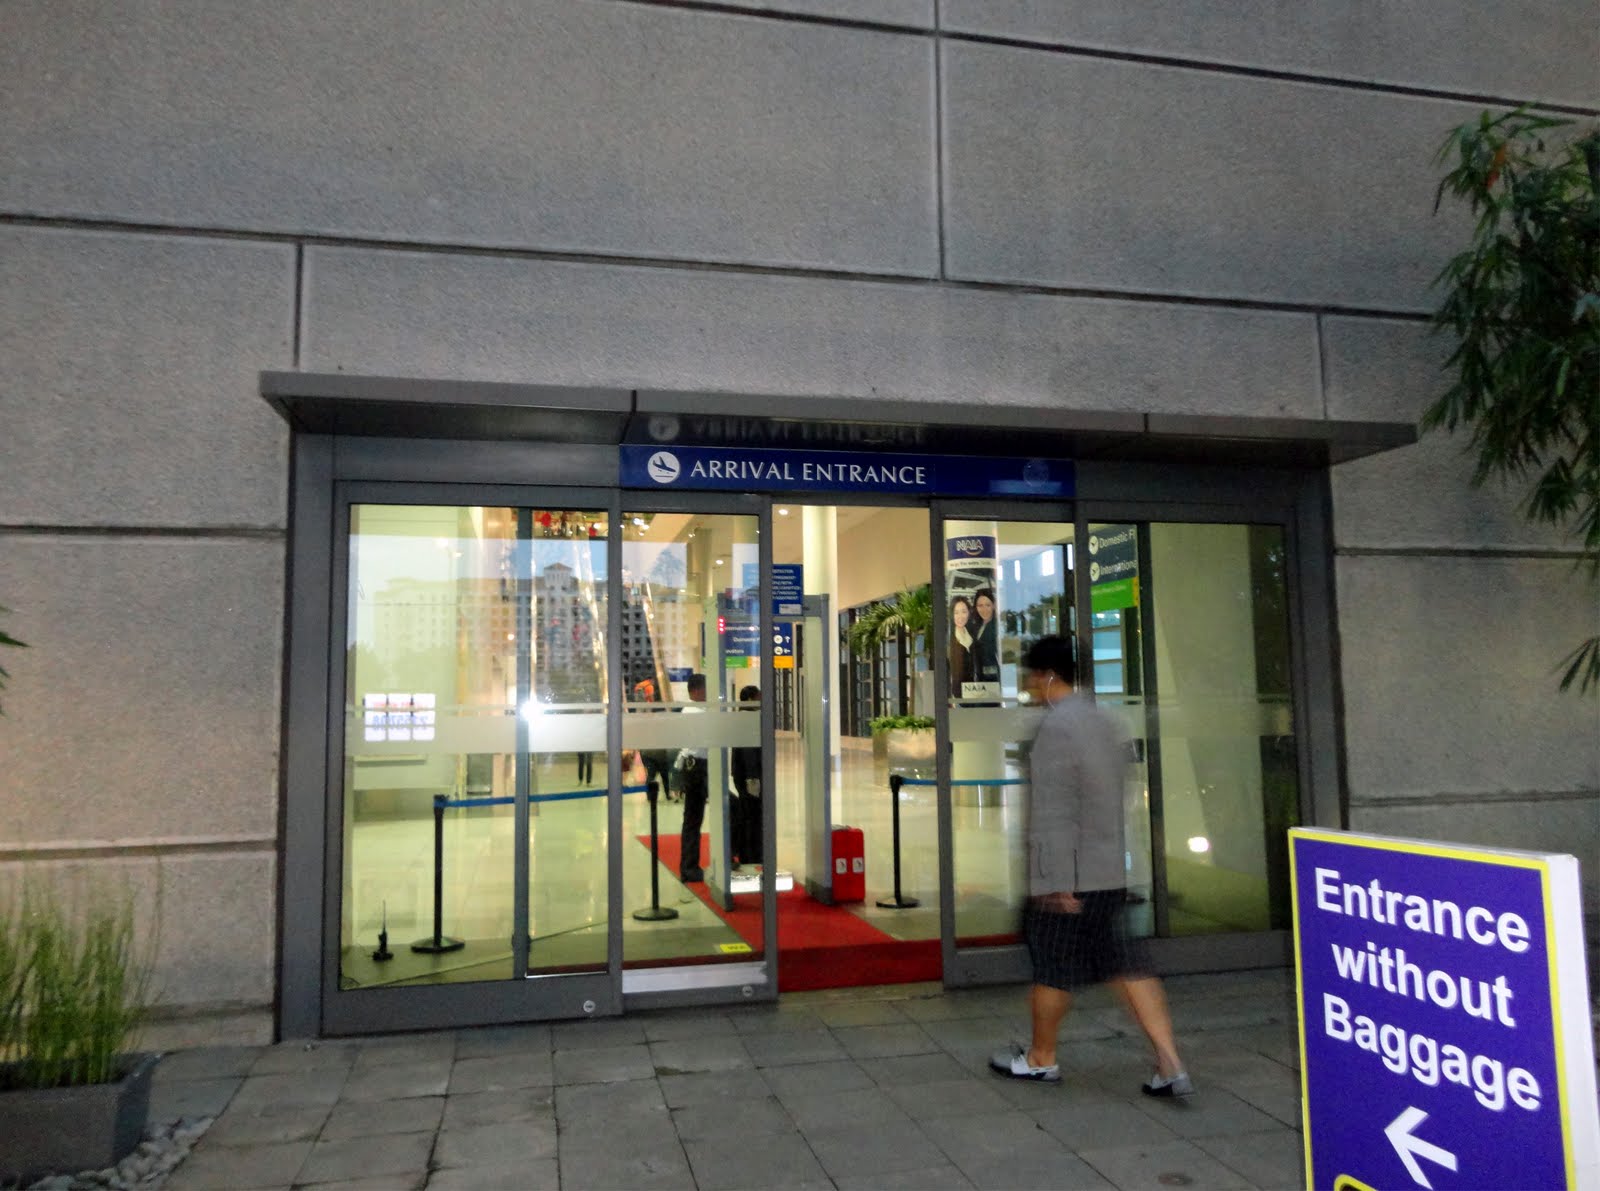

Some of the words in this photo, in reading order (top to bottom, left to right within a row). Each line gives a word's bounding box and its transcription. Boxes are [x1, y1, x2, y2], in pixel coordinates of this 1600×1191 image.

[690, 459, 795, 481] ARRIVAL
[803, 463, 927, 485] ENTRANCE
[956, 539, 984, 551] NAIA
[1099, 531, 1128, 549] Domestic
[1100, 560, 1137, 576] Internationa
[1315, 867, 1531, 953] Entrance
[1332, 941, 1517, 1027] without
[1323, 992, 1542, 1111] Baggage
